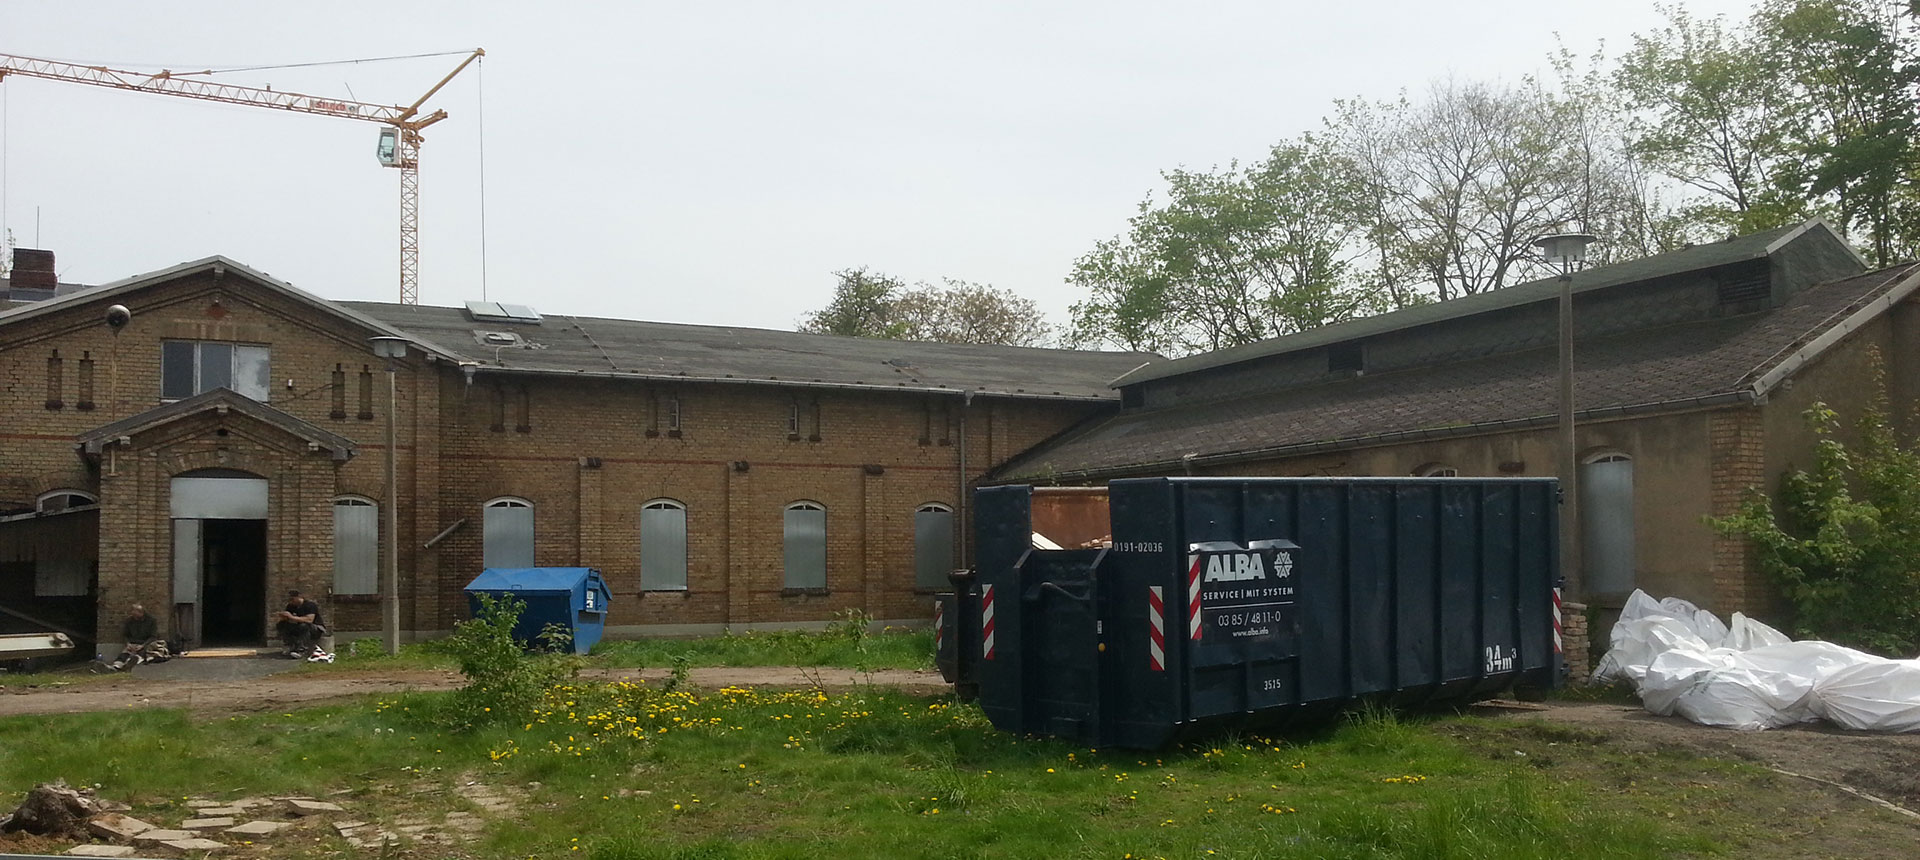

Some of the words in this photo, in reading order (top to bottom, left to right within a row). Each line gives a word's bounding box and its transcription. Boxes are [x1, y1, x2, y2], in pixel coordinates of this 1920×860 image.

[1113, 542, 1163, 553] 0191-02036
[1204, 553, 1266, 582] ALBA
[1203, 590, 1239, 601] SERVICE
[1246, 589, 1260, 598] MIT
[1263, 587, 1294, 597] SYSTEM
[1218, 615, 1229, 626] 03
[1231, 614, 1242, 626] 85
[1264, 679, 1281, 691] 3515
